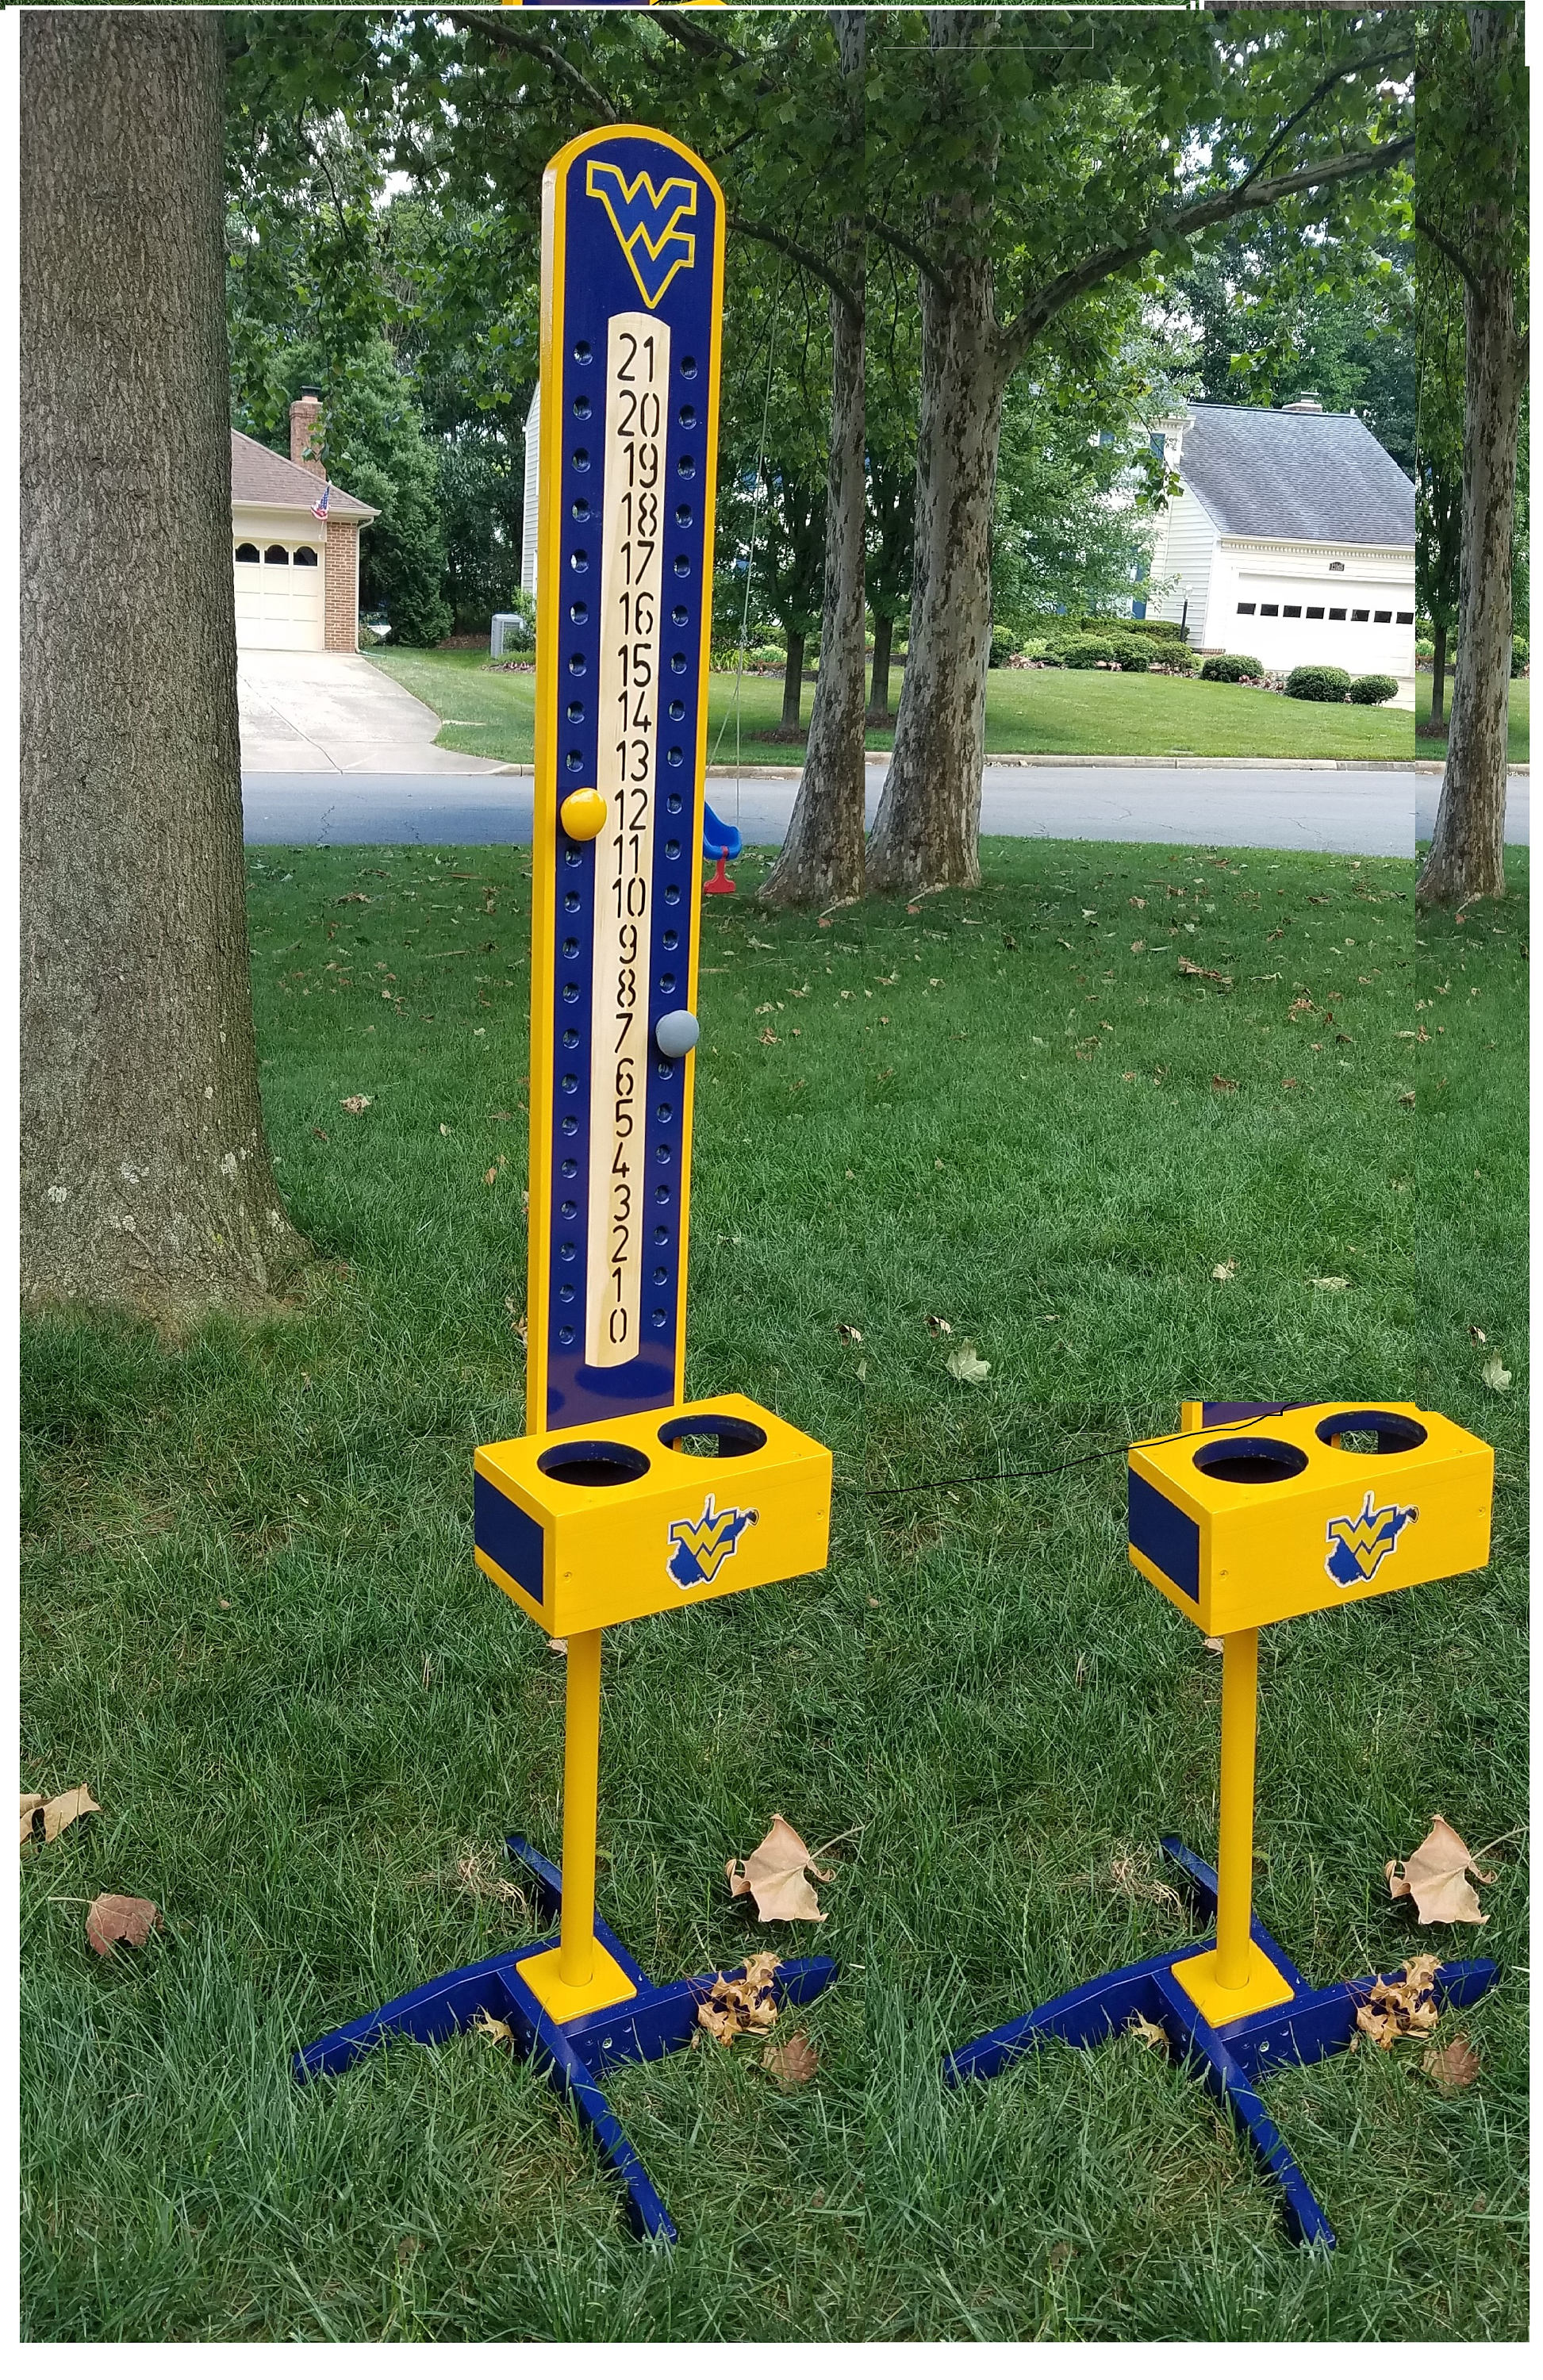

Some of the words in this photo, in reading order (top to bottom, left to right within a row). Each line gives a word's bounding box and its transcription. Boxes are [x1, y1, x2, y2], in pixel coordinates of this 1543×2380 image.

[617, 333, 654, 382] 21
[617, 390, 660, 437] 20
[623, 441, 658, 488] 19
[621, 492, 658, 537] 18
[620, 539, 655, 585] 17
[619, 591, 654, 635] 16
[617, 643, 651, 687] 15
[617, 690, 652, 733] 14
[616, 739, 649, 782] 13
[614, 789, 648, 831] 12
[613, 834, 639, 874] 11
[612, 877, 646, 918] 10
[619, 923, 638, 964] 9
[616, 968, 636, 1008] 8
[615, 1012, 634, 1054] 7
[616, 1058, 635, 1097] 6
[615, 1098, 634, 1138] 5
[612, 1142, 630, 1178] 4
[613, 1184, 631, 1222] 3
[612, 1224, 629, 1263] 2
[611, 1266, 622, 1302] 1
[609, 1307, 628, 1344] 0
